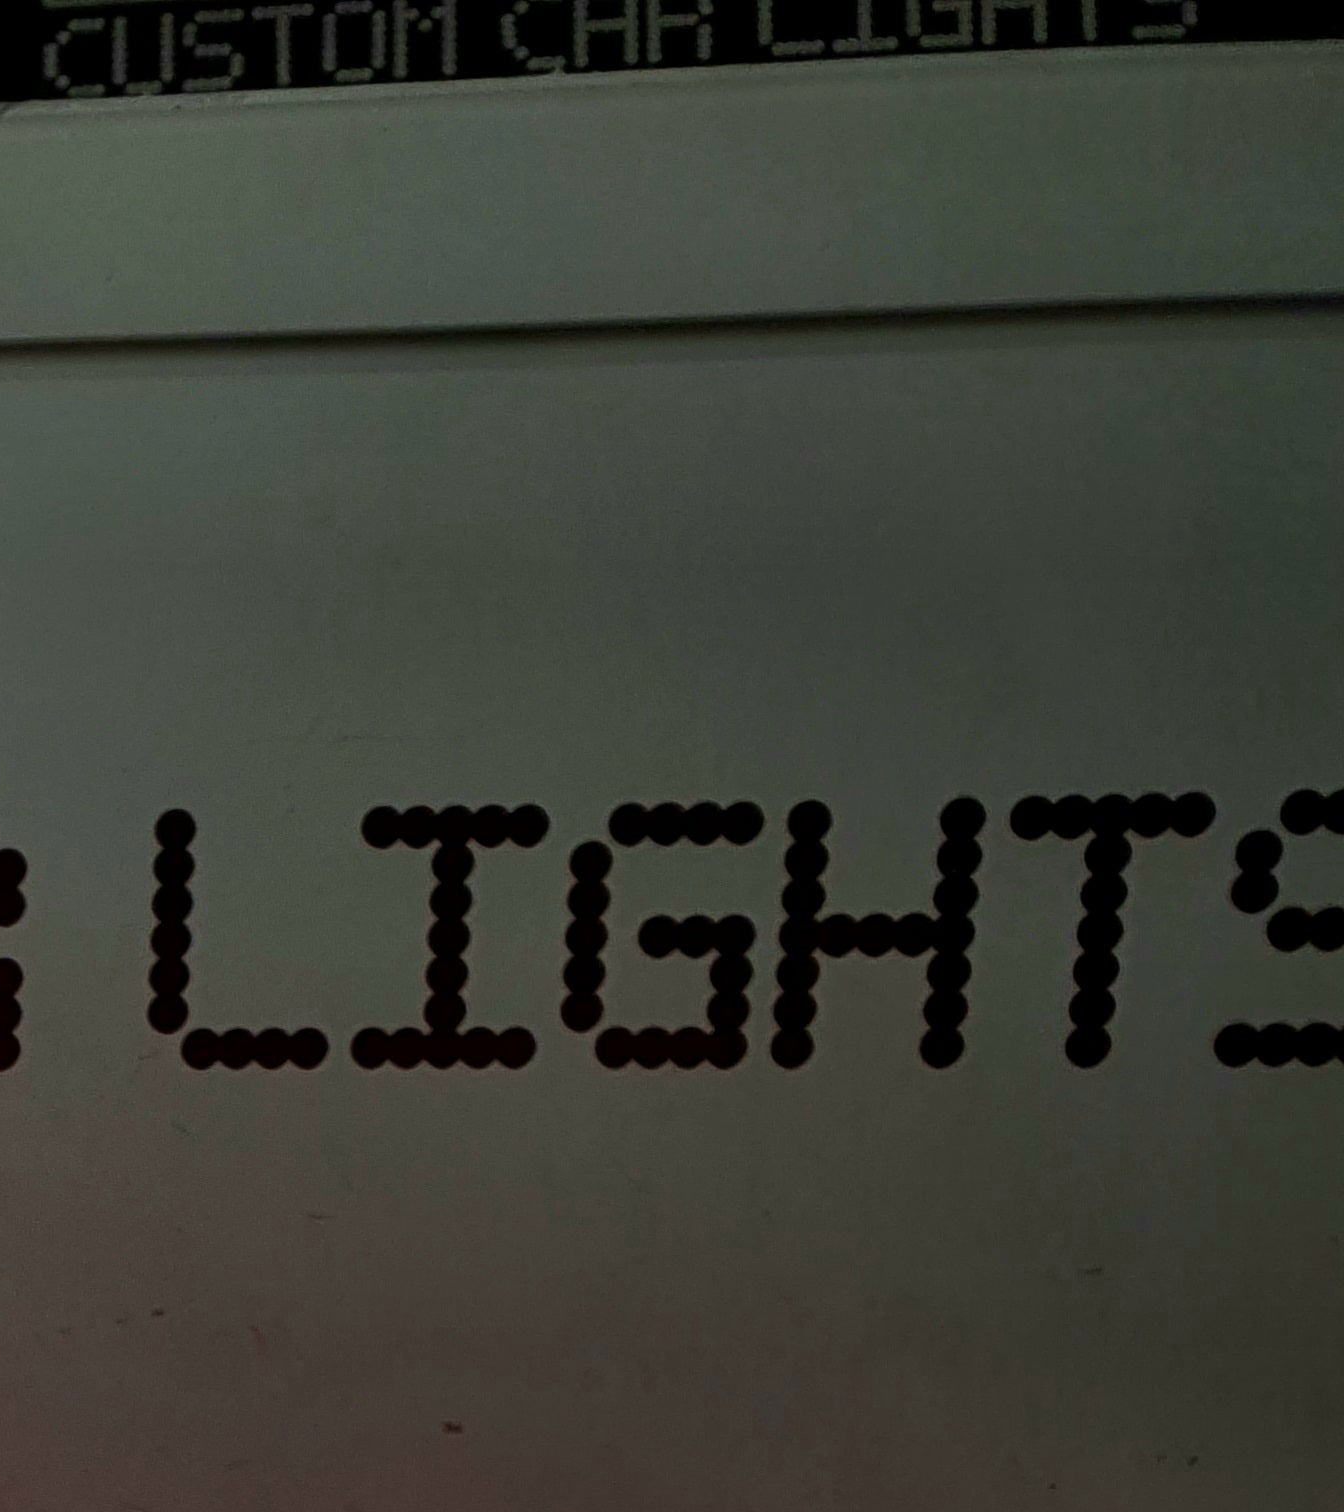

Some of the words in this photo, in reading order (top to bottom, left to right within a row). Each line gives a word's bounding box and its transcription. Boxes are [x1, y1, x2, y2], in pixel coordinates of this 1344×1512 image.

[40, 0, 460, 98] CUSTOM
[499, 0, 714, 74] CAR
[146, 789, 1344, 1067] LIGHTS
